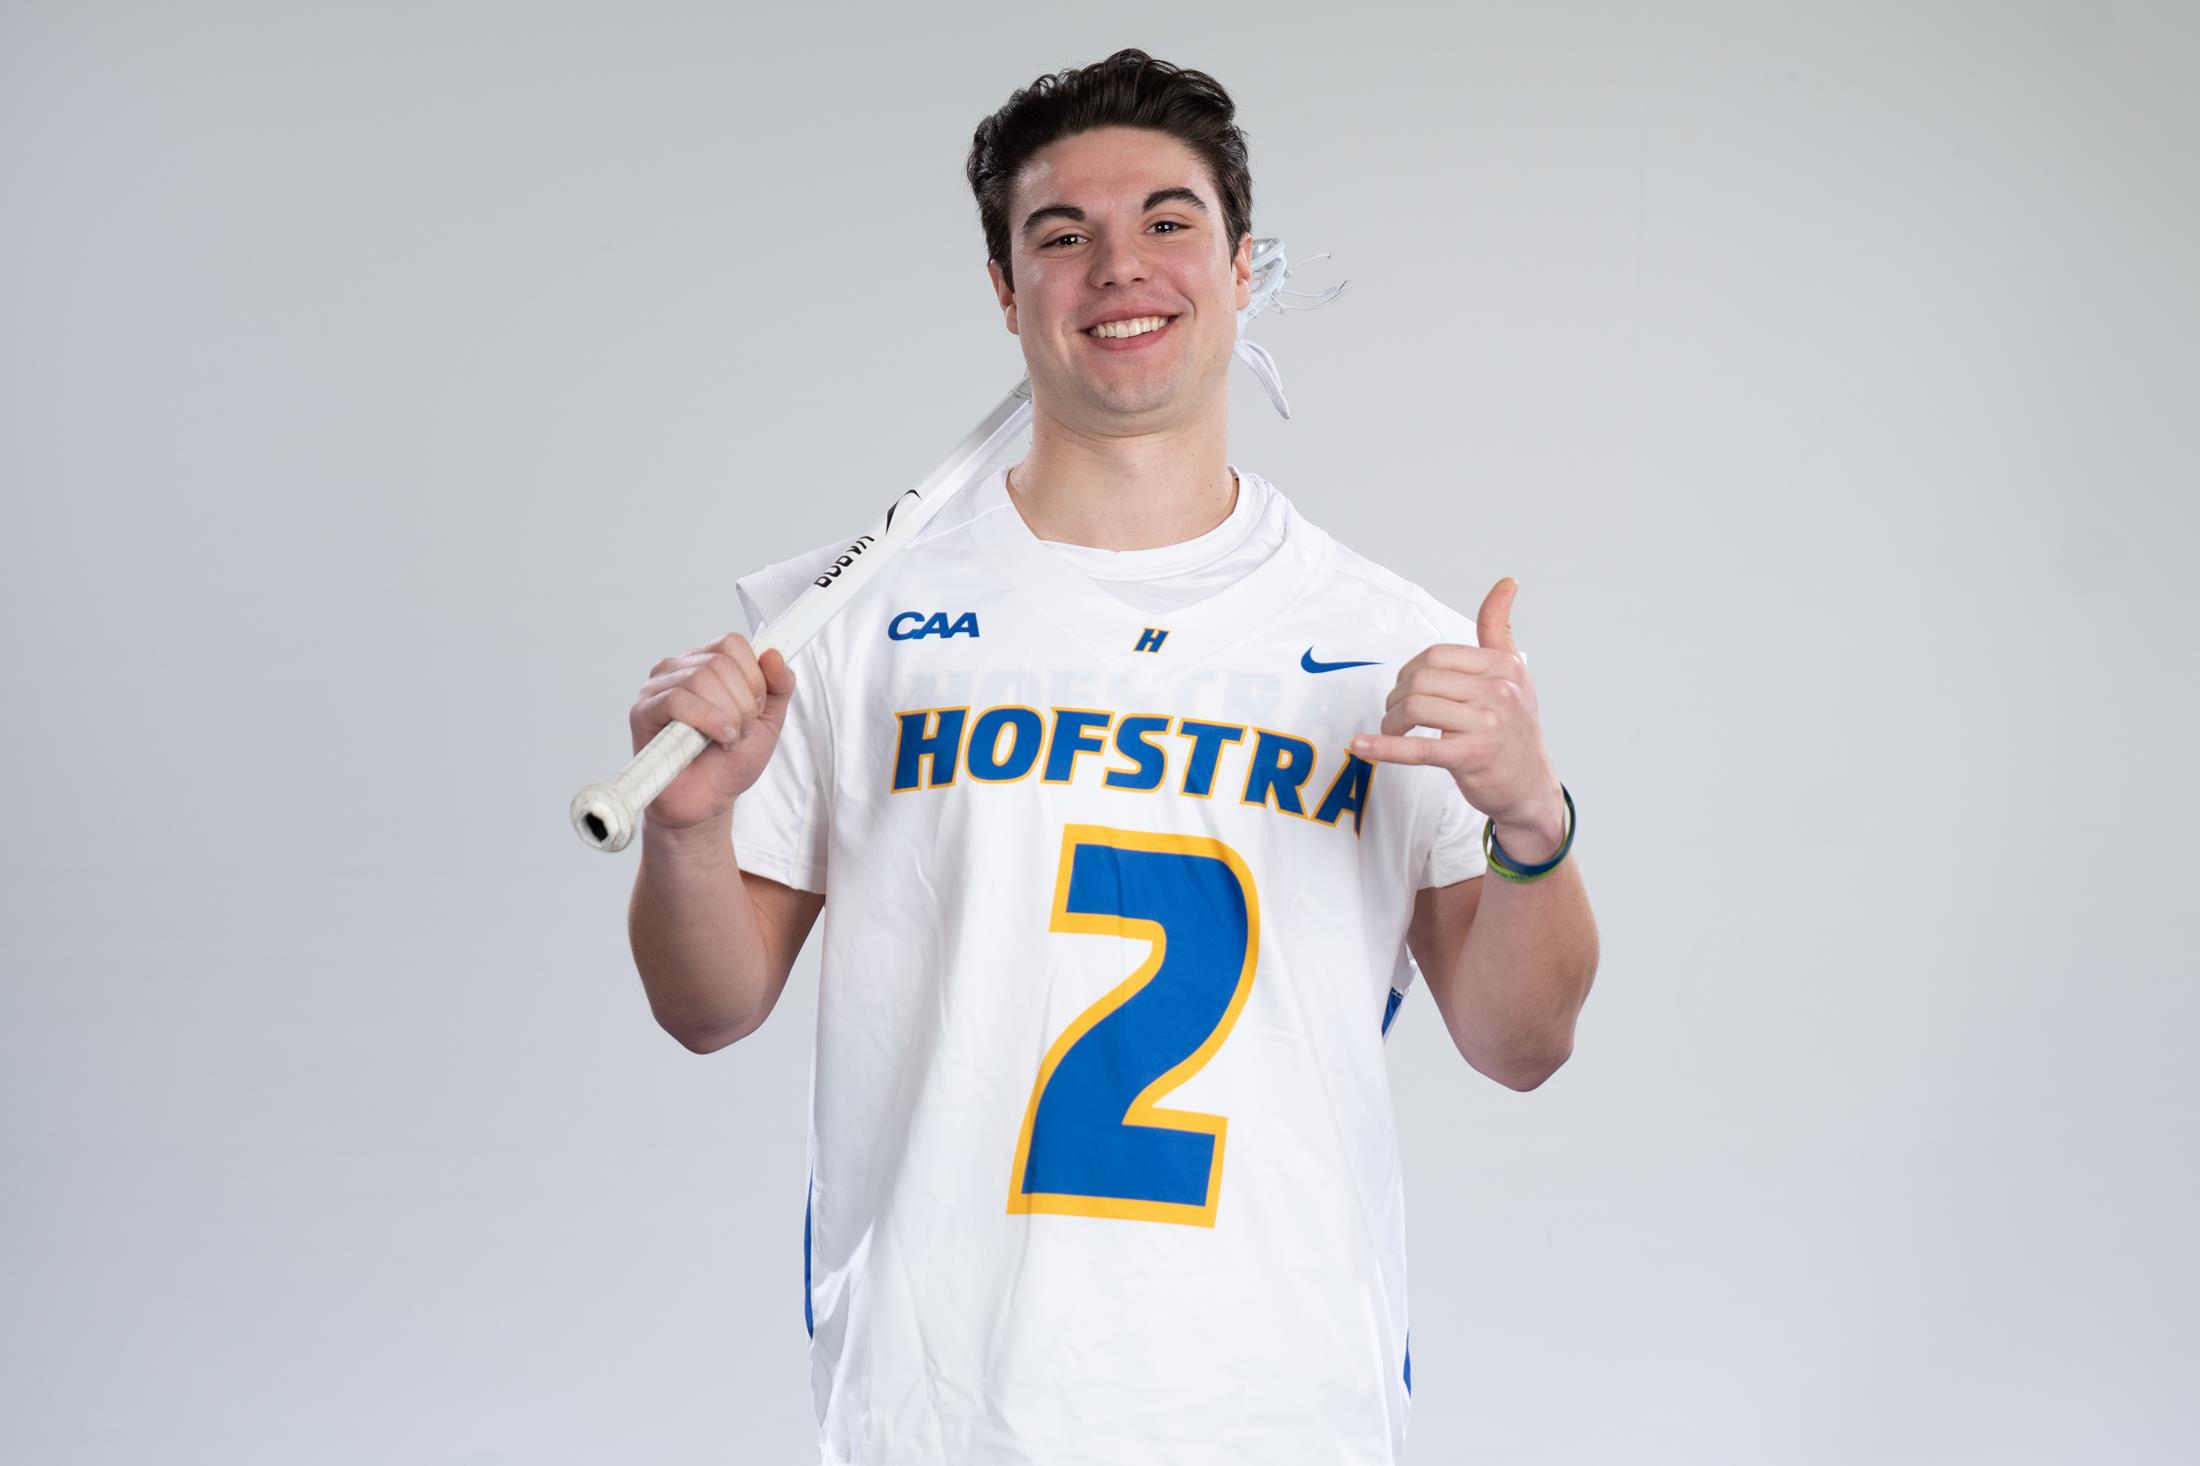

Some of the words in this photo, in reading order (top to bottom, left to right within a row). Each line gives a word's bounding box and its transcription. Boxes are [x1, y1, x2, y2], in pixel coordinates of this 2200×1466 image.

[888, 611, 980, 641] CAA
[1133, 627, 1170, 653] H
[890, 704, 1377, 840] HOFSTRA
[1006, 823, 1261, 1229] 2
